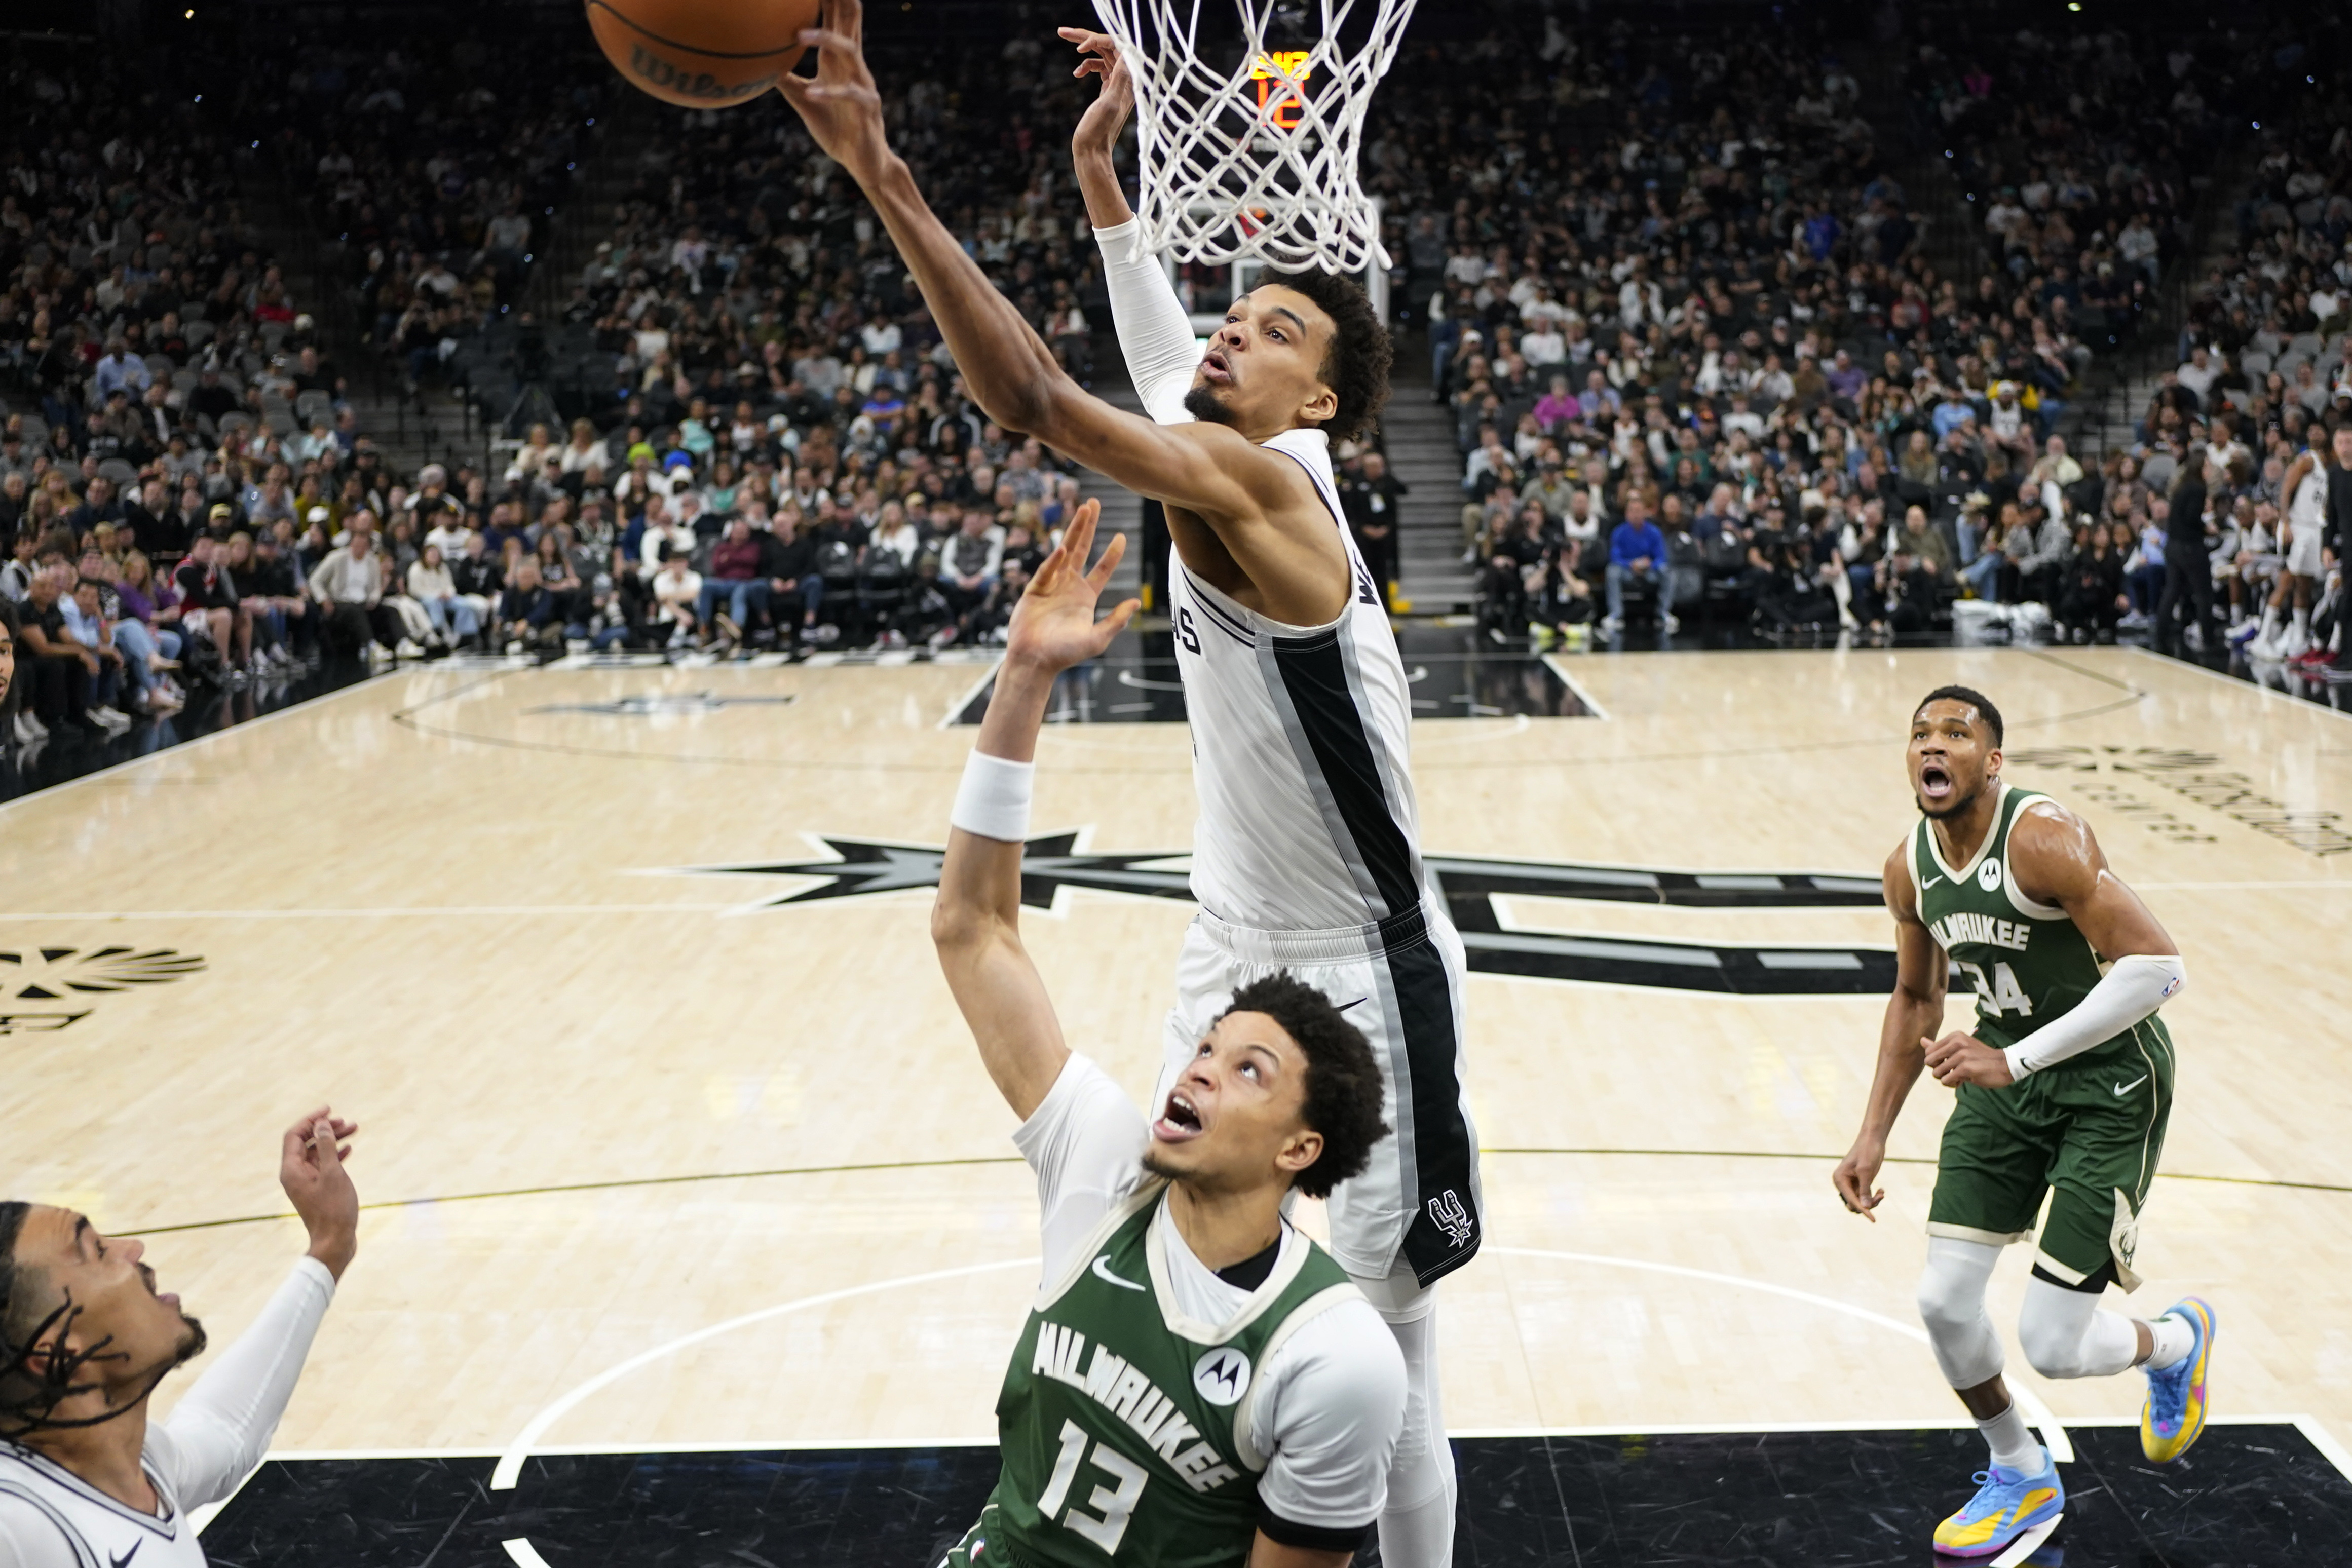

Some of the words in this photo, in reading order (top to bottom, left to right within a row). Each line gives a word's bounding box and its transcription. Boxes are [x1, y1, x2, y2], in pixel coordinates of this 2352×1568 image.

[1958, 961, 2033, 1019] 34
[1032, 1320, 1240, 1493] MILWAUKEE
[1037, 1418, 1150, 1556] 13
